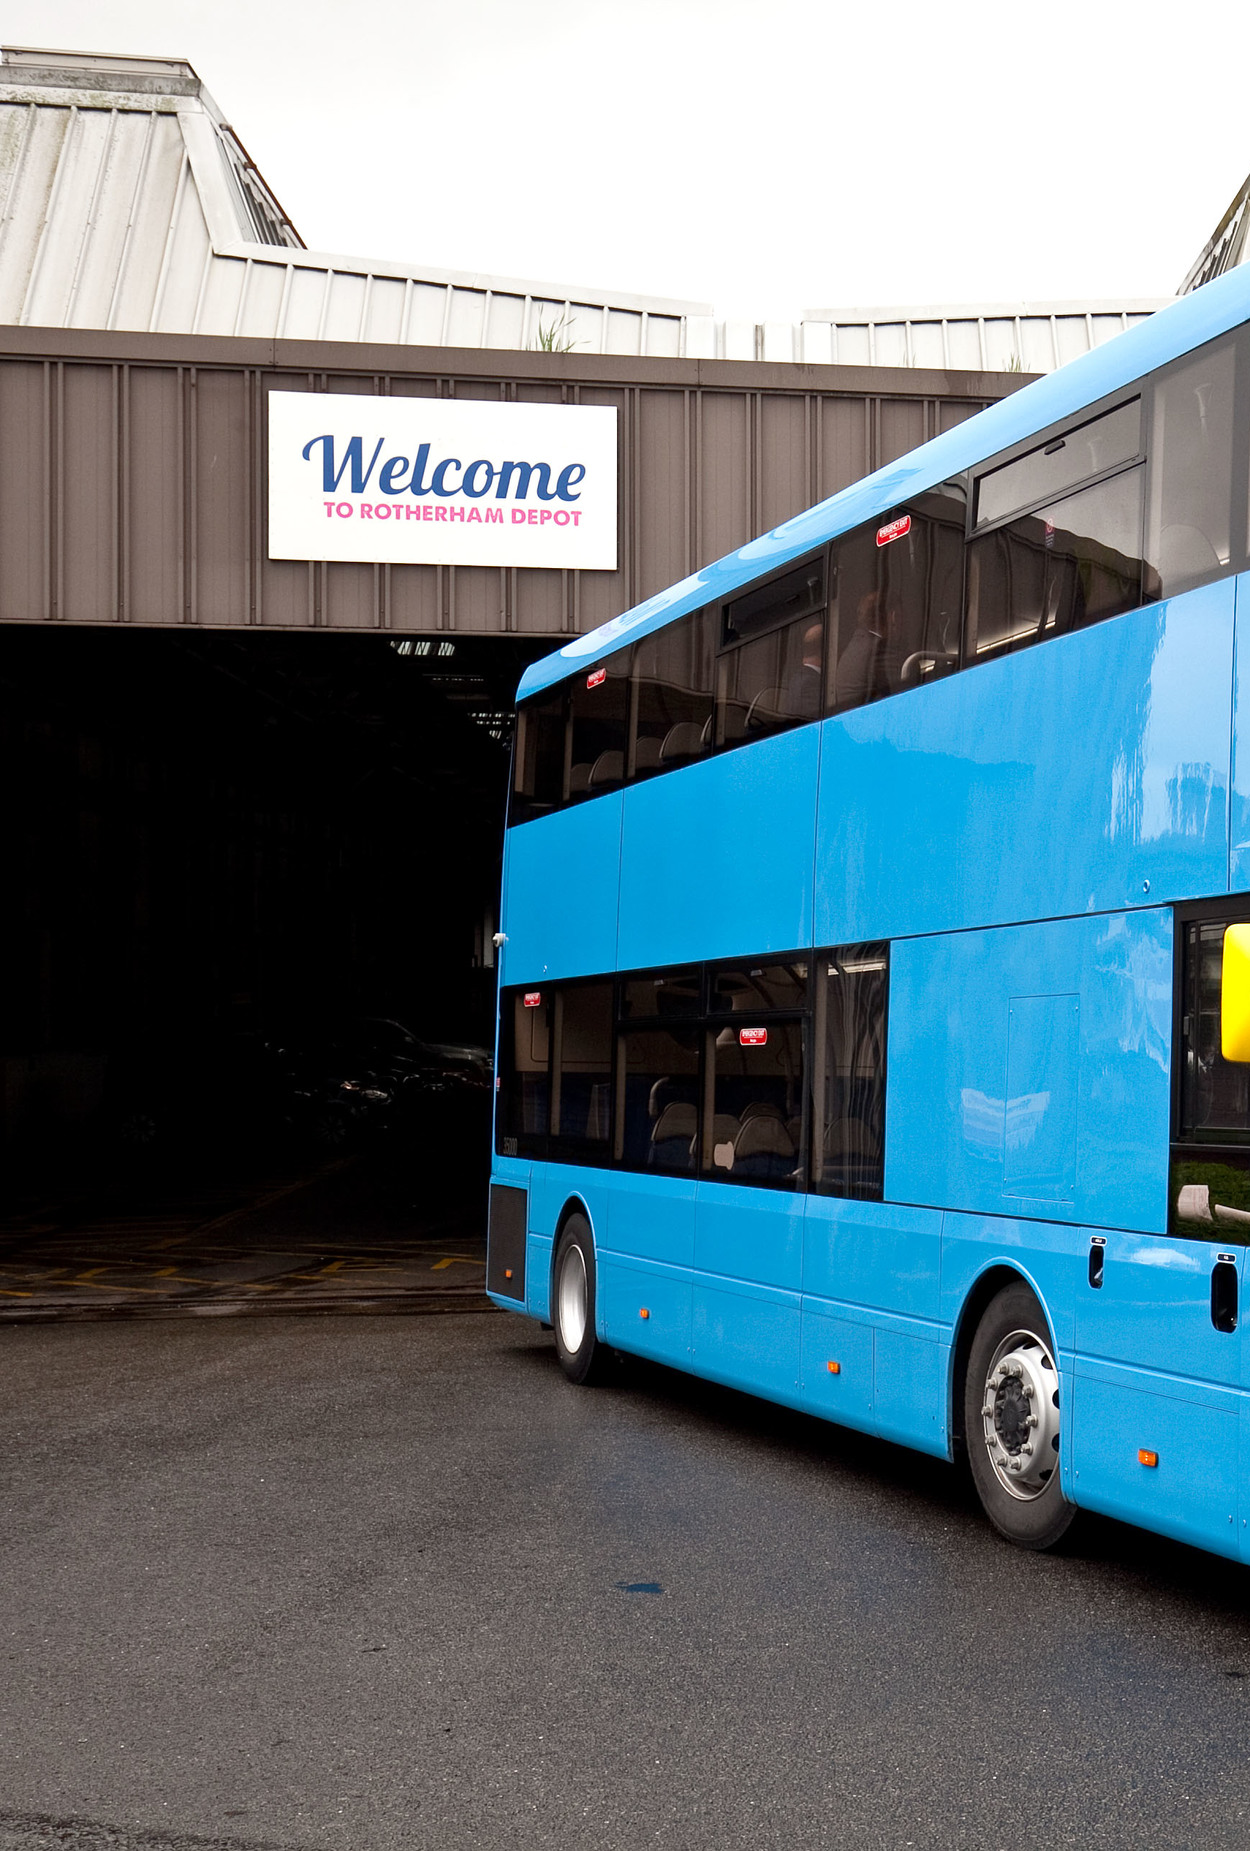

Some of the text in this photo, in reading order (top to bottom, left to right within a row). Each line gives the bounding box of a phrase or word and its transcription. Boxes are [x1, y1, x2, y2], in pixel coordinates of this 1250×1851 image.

[302, 434, 586, 502] Welcome
[323, 501, 582, 526] TO ROTHERHAM DEPOT
